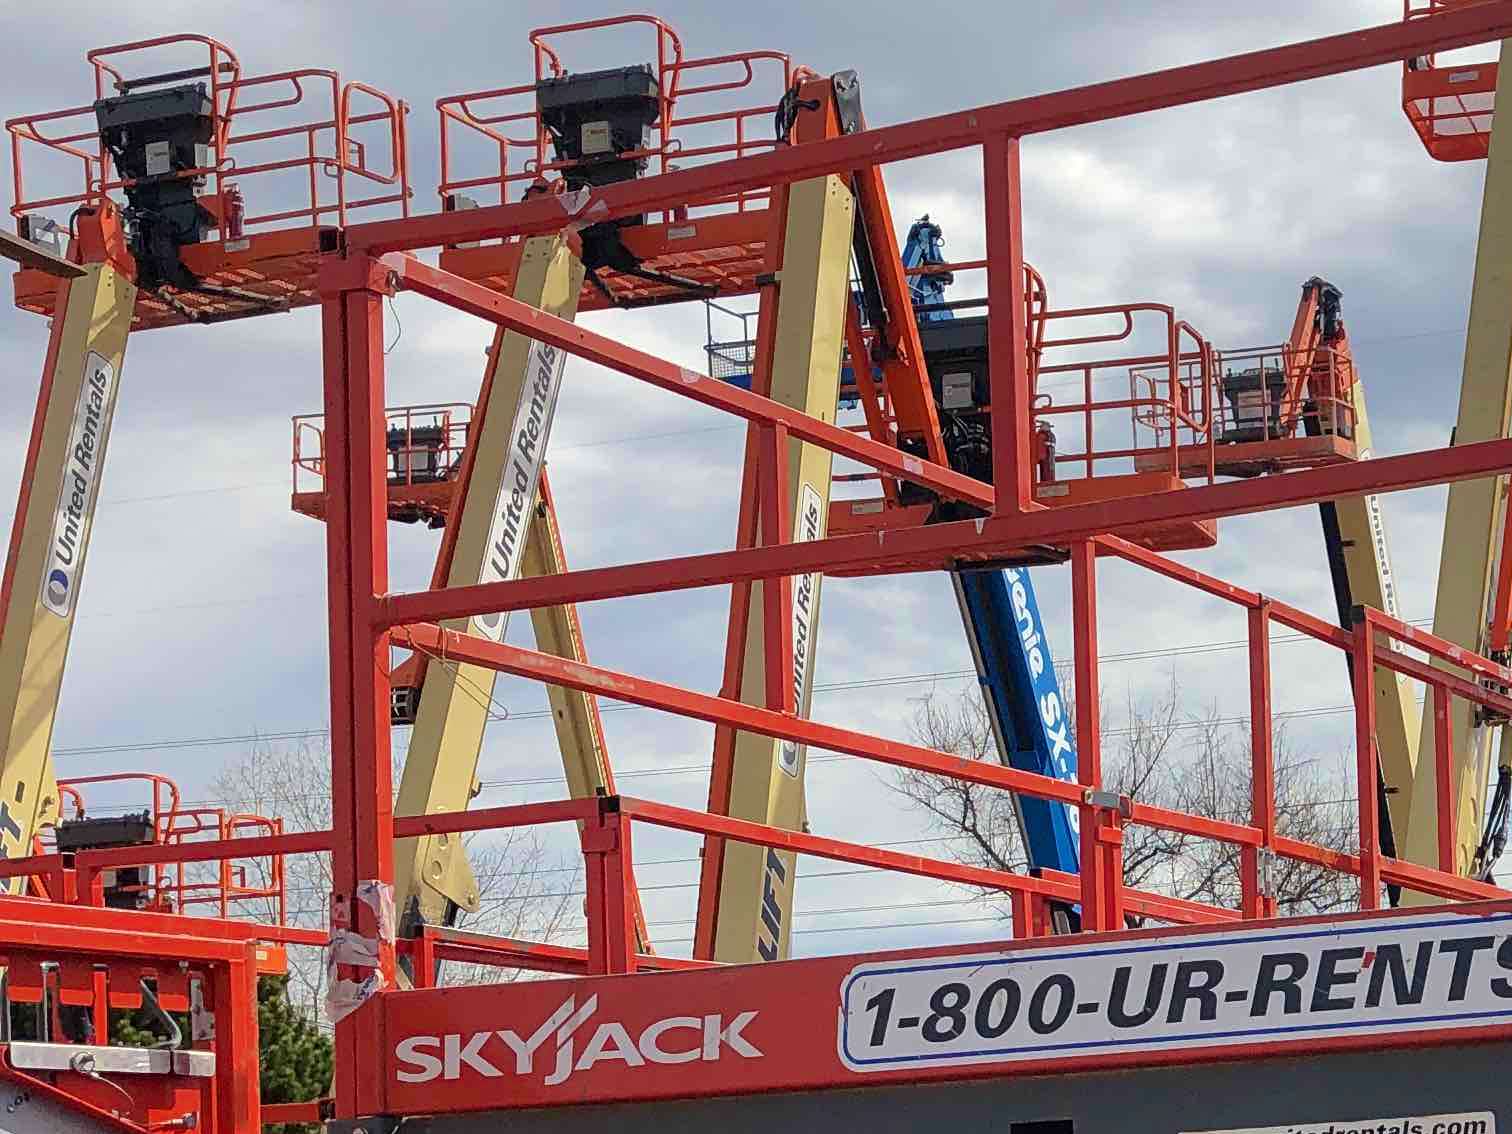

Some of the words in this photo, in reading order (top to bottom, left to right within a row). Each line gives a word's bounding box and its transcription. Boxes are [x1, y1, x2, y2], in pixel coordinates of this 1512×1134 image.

[55, 469, 87, 566] United
[73, 368, 107, 472] Rentals
[491, 461, 528, 579] United
[517, 343, 557, 464] Rentals
[394, 992, 765, 1086] SKYJACK
